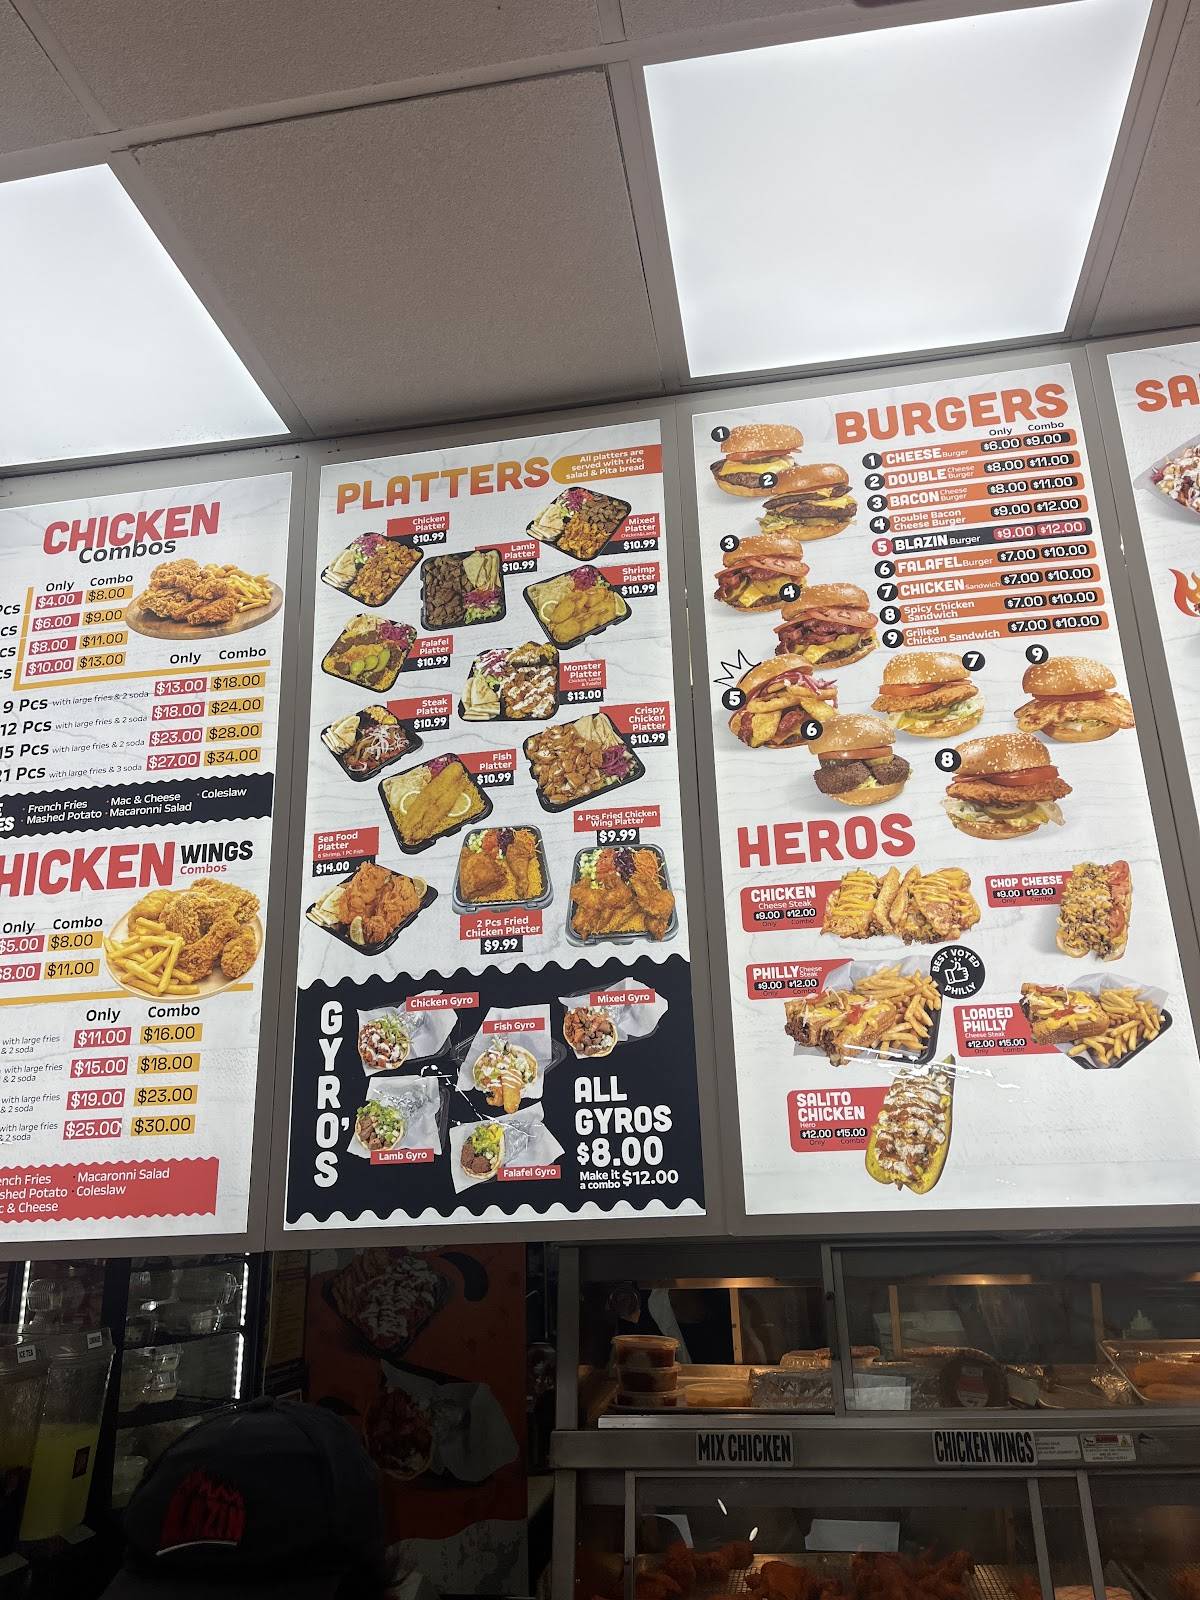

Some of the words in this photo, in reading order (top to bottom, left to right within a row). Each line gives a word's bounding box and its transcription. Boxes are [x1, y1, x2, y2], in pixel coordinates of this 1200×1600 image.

[835, 383, 1069, 445] BURGERS
[989, 427, 1013, 437] Only
[1027, 422, 1065, 432] Combo
[886, 447, 942, 465] CHEESE
[942, 449, 969, 458] Burger
[983, 438, 1020, 451] $6.00
[1025, 433, 1062, 446] $9.00
[593, 452, 628, 462] platters
[565, 470, 589, 479] salad
[600, 467, 618, 475] Pita
[619, 463, 645, 473] bread
[571, 462, 601, 471] served
[603, 459, 624, 468] with
[870, 475, 880, 488] 2
[888, 468, 947, 487] DOUBLE
[986, 459, 1024, 473] $8.00
[1029, 454, 1070, 467] $11.00
[336, 456, 550, 514] PLATTERS
[412, 515, 445, 525] Chicken
[415, 522, 446, 532] Platter
[628, 516, 656, 525] Mixed
[43, 501, 221, 555] CHICKEN
[624, 523, 656, 532] Platter
[412, 532, 444, 544] $10.99
[894, 535, 948, 551] BLAZIN
[949, 535, 981, 545] Burger
[997, 525, 1034, 538] $9.00
[1040, 521, 1083, 534] $12.00
[79, 539, 177, 564] Combos
[511, 542, 535, 551] Lamb
[623, 539, 656, 551] $10.99
[504, 549, 536, 559] Platter
[502, 560, 535, 572] $10.99
[46, 580, 75, 592] Only
[90, 574, 133, 587] Combo
[882, 586, 892, 599] 7
[900, 579, 965, 596] CHICKEN
[1003, 572, 1040, 585] $7.00
[1047, 567, 1092, 581] $10.00
[37, 593, 75, 608] $4.00
[88, 587, 125, 602] $8.00
[884, 609, 895, 622] 8
[904, 603, 932, 615] Spicy
[935, 600, 975, 610] Chicken
[1007, 595, 1044, 608] $7.00
[1051, 591, 1096, 605] $10.00
[907, 610, 958, 621] Sandwich
[421, 638, 449, 647] Falafel
[169, 652, 201, 665] Only
[219, 646, 267, 660] Combo
[419, 645, 449, 655] Platter
[27, 660, 72, 676] $10.00
[79, 653, 123, 670] $13.00
[417, 656, 448, 668] $10.99
[563, 662, 601, 671] Monster
[570, 669, 602, 679] Platter
[3, 701, 14, 714] 9
[19, 698, 48, 712] Pcs
[52, 696, 71, 706] with
[155, 679, 204, 696] $13.00
[213, 674, 260, 690] $18.00
[567, 690, 601, 701] $13.00
[0, 723, 17, 737] 12
[22, 720, 51, 734] Pcs
[154, 703, 201, 720] $18.00
[211, 698, 261, 715] $24.00
[635, 706, 665, 716] Crispy
[628, 714, 666, 724] Chicken
[632, 721, 666, 731] Platter
[630, 733, 666, 745] $10.99
[201, 787, 247, 799] Coleslaw
[26, 812, 66, 825] Mashed
[68, 810, 102, 822] Potato
[110, 804, 162, 817] Macaronni
[164, 802, 192, 812] Salad
[28, 801, 61, 813] French
[64, 800, 87, 810] Fries
[620, 810, 657, 818] Chicken
[590, 818, 613, 828] Wing
[615, 817, 644, 826] Platter
[318, 835, 334, 843] Sea
[335, 831, 358, 841] Food
[599, 829, 637, 843] $9.99
[737, 813, 916, 869] HEROS
[181, 840, 253, 865] WINGS
[318, 842, 349, 851] Platter
[180, 864, 227, 875] Combos
[316, 861, 350, 874] $14.00
[990, 877, 1019, 888] CHOP
[1021, 875, 1063, 887] CHEESE
[750, 885, 816, 903] CHICKEN
[758, 901, 787, 910] Cheese
[788, 900, 812, 908] Steak
[2, 920, 35, 934] Only
[53, 916, 103, 931] Combo
[50, 933, 93, 949] $8.00
[932, 950, 949, 972] BEST
[949, 949, 981, 969] VOTED
[753, 965, 799, 980] PHILLY
[944, 982, 976, 995] PHILLY
[410, 996, 448, 1008] Chicken
[450, 994, 474, 1008] Gyro
[597, 992, 625, 1002] Mixed
[627, 991, 650, 1003] Gyro
[86, 1007, 121, 1023] Only
[148, 1004, 200, 1018] Combo
[961, 1006, 1014, 1020] LOADED
[963, 1019, 1007, 1032] PHILLY
[77, 1029, 127, 1047] $11.00
[143, 1025, 195, 1043] $16.00
[574, 1076, 628, 1103] ALL
[796, 1091, 852, 1107] SALITO
[575, 1105, 672, 1136] GYROS
[798, 1105, 866, 1122] CHICKEN
[65, 1120, 120, 1139] $25.00
[134, 1117, 191, 1135] $30.00
[577, 1136, 664, 1167] $8.00
[77, 1170, 136, 1182] Macaronni
[139, 1168, 170, 1180] Salad
[503, 1168, 529, 1178] Falafel
[532, 1167, 556, 1178] Gyro
[580, 1170, 608, 1181] Make
[610, 1170, 620, 1180] it
[587, 1180, 620, 1190] combo
[622, 1170, 679, 1187] $12.00
[698, 1433, 726, 1462] MIX
[727, 1433, 791, 1462] CHICKEN
[935, 1431, 991, 1463] CHICKEN
[992, 1431, 1034, 1464] WINGS
